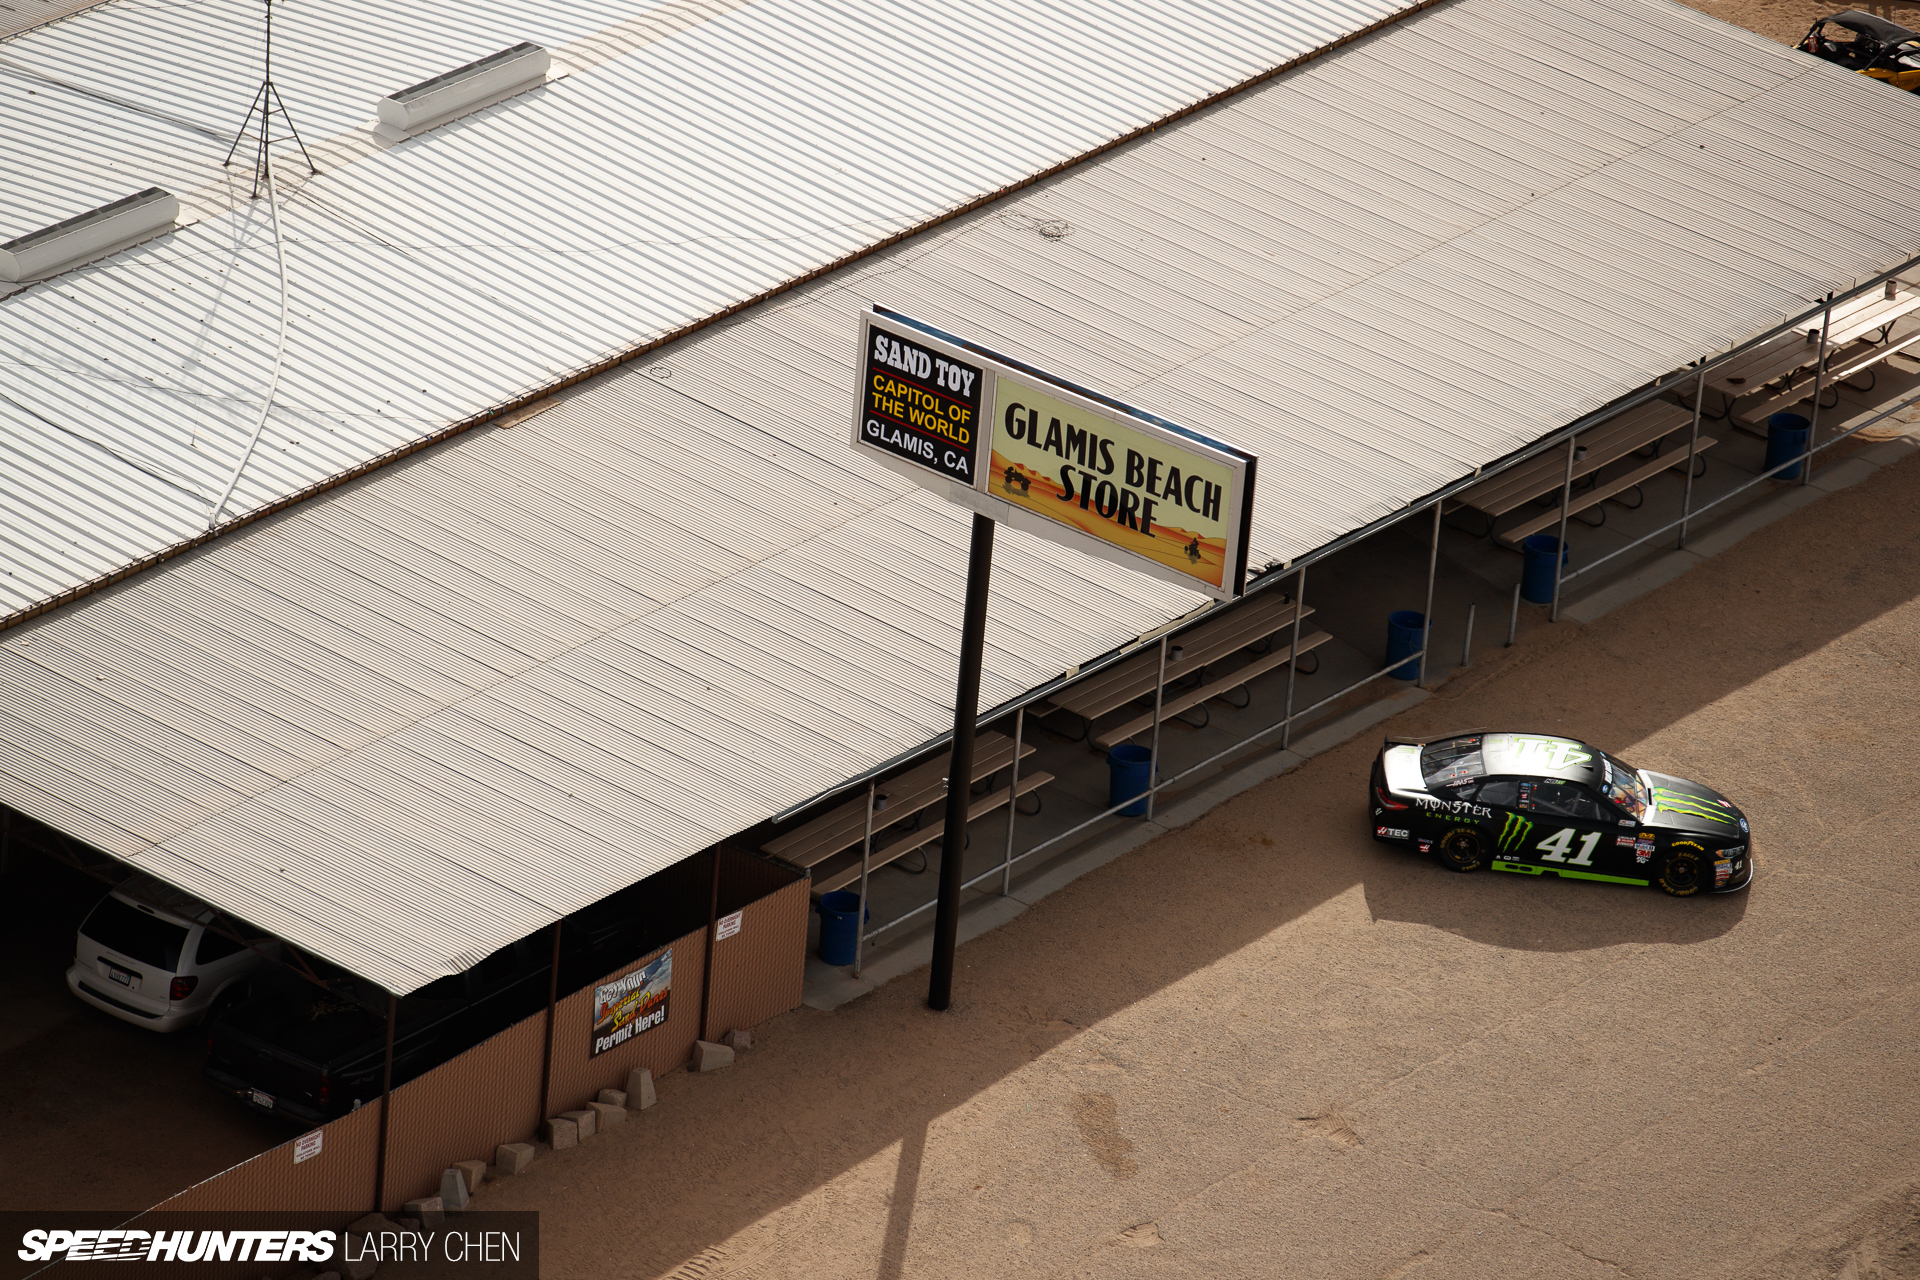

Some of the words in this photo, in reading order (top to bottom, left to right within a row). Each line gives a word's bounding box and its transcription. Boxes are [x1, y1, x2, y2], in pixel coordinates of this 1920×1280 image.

[874, 335, 931, 379] SAND
[936, 358, 975, 398] TOY
[872, 393, 904, 417] THE
[908, 405, 970, 444] WORLD
[873, 374, 944, 415] CAPITOL
[949, 401, 971, 422] OF
[866, 420, 938, 465] GLAMIS,
[944, 450, 969, 475] CA
[1004, 402, 1115, 476] GLAMIS
[1126, 448, 1222, 523] BEACH
[1056, 464, 1158, 539] STORE
[1415, 798, 1492, 819] MONSTER
[1426, 811, 1480, 825] ENERGY
[1535, 827, 1602, 867] 41
[1637, 849, 1651, 858] 3M
[1678, 852, 1700, 861] EAGLE
[1734, 860, 1743, 870] 41
[597, 981, 643, 1025] Imperial
[599, 985, 618, 1004] Get
[620, 970, 647, 994] Your
[611, 1001, 638, 1033] Sand
[639, 986, 668, 1014] Dunes
[595, 1022, 633, 1054] Permit
[635, 1005, 665, 1035] Here!
